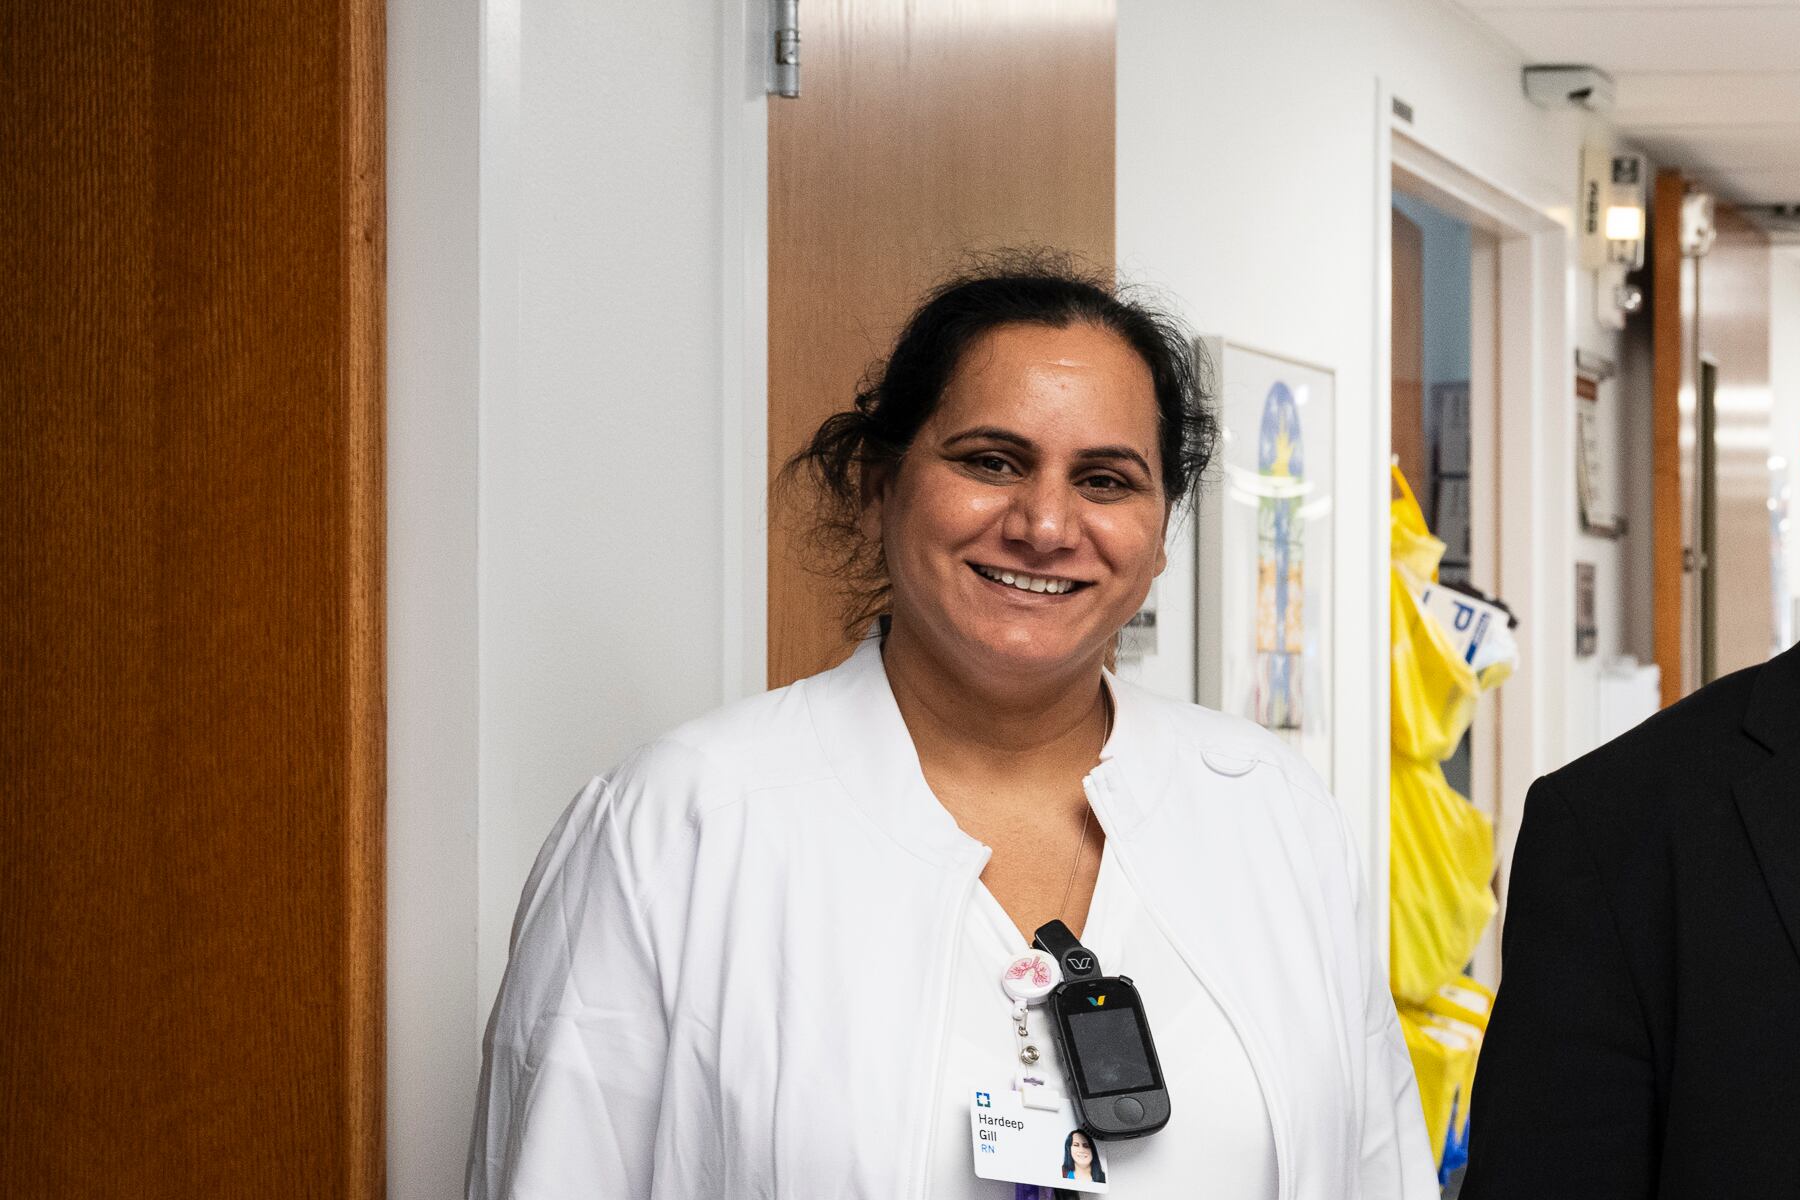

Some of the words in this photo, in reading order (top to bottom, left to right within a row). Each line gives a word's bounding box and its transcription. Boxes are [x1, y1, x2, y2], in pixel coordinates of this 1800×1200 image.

[978, 1113, 1024, 1131] Hardeep
[979, 1129, 997, 1142] Gill
[981, 1143, 996, 1154] RN
